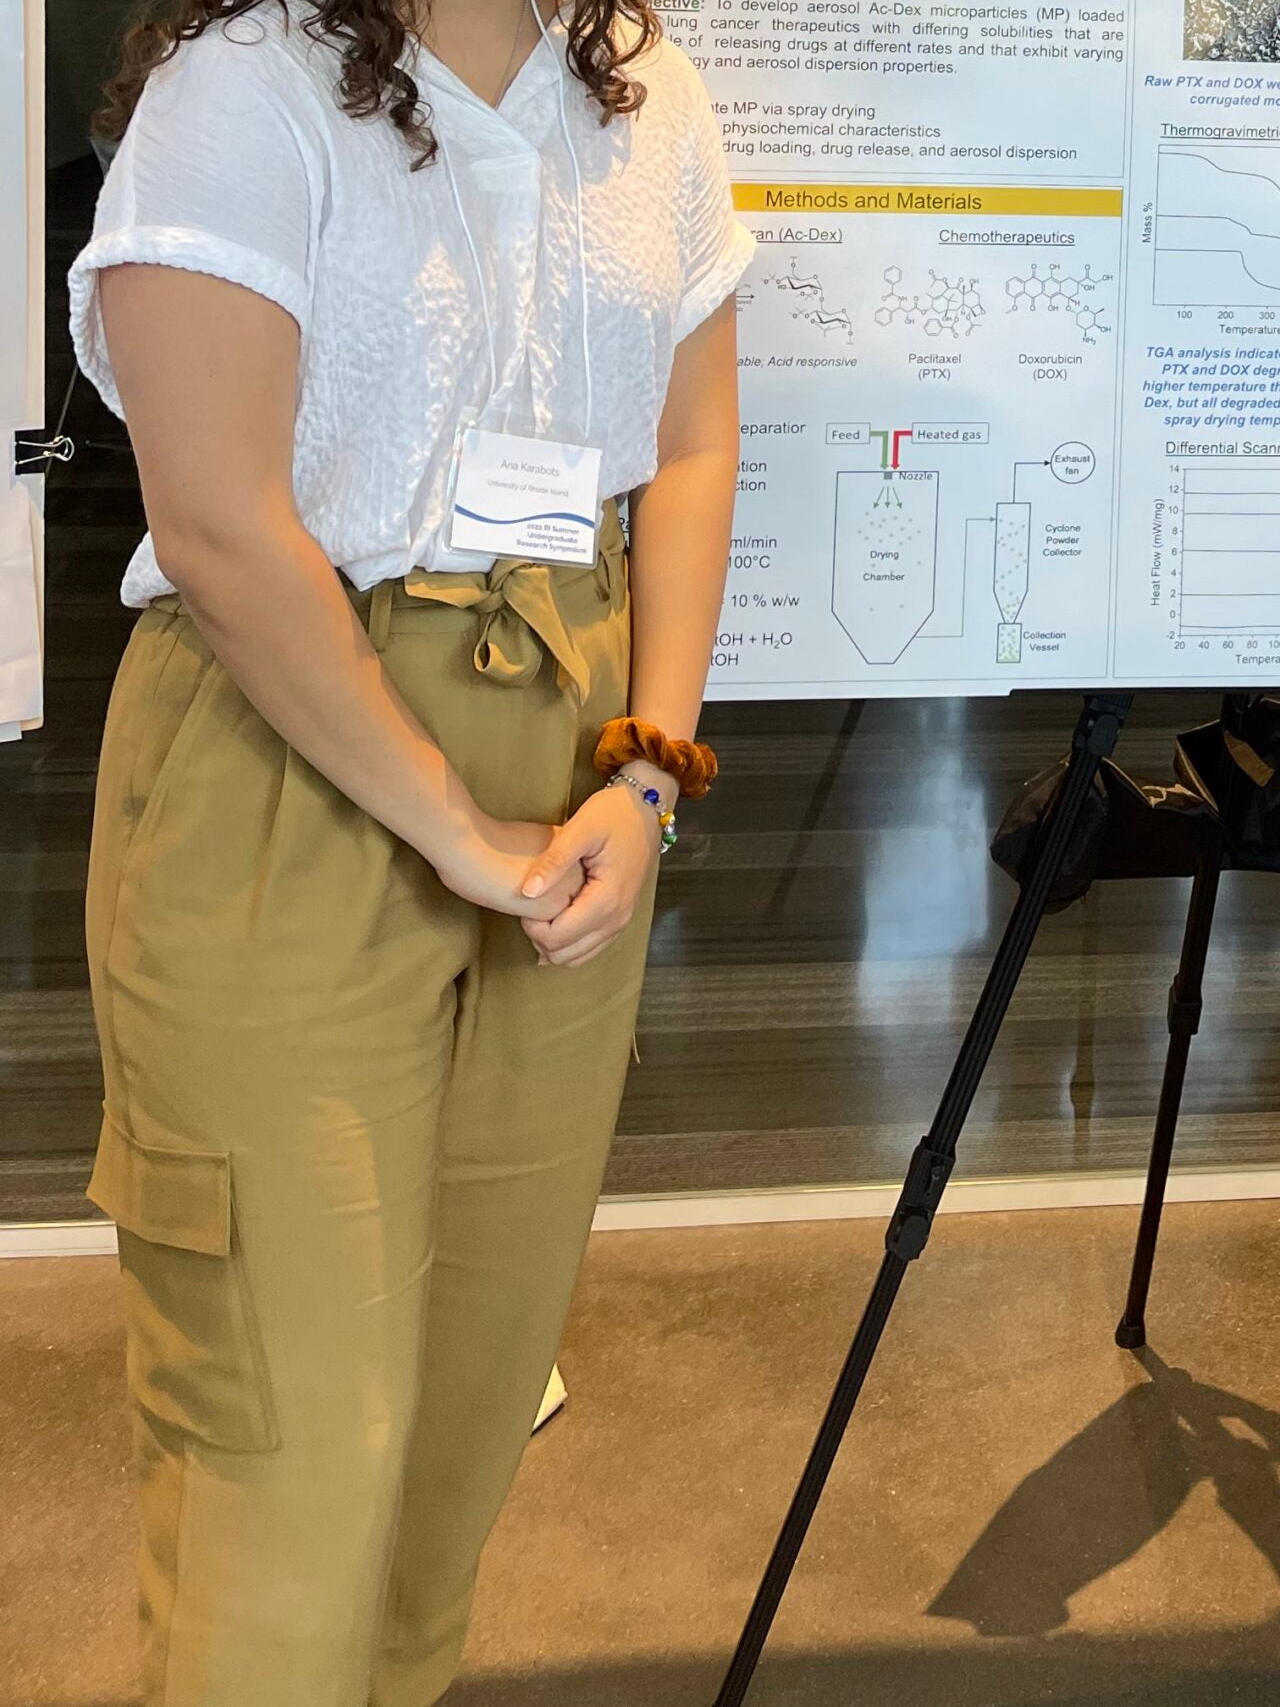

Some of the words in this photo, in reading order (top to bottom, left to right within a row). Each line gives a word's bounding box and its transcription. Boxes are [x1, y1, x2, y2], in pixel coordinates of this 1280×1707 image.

[1143, 75, 1173, 87] Raw
[1175, 75, 1204, 87] PTX
[1205, 76, 1231, 88] and
[1232, 77, 1264, 89] DOX
[765, 190, 849, 208] Methods
[854, 191, 890, 209] and
[896, 192, 982, 210] Materials
[938, 229, 1075, 248] Chemotherapeutics
[907, 353, 962, 364] Paclitaxel
[1017, 353, 1083, 364] Doxorubicin
[917, 368, 951, 381] (PTX)
[1032, 368, 1068, 381] (DOX)
[831, 429, 861, 440] Feed
[916, 429, 959, 439] Heated
[961, 431, 982, 443] gas
[1165, 440, 1238, 455] Differential
[1055, 454, 1091, 463] Exhaust
[899, 471, 933, 481] Nozzle
[1064, 466, 1080, 475] fan
[1044, 523, 1081, 534] Cyclone
[1045, 536, 1080, 544] Powder
[869, 550, 900, 560] Drying
[1041, 548, 1083, 557] Collector
[863, 572, 905, 582] Chamber
[1022, 630, 1067, 640] Collection
[1028, 643, 1060, 651] Vessel
